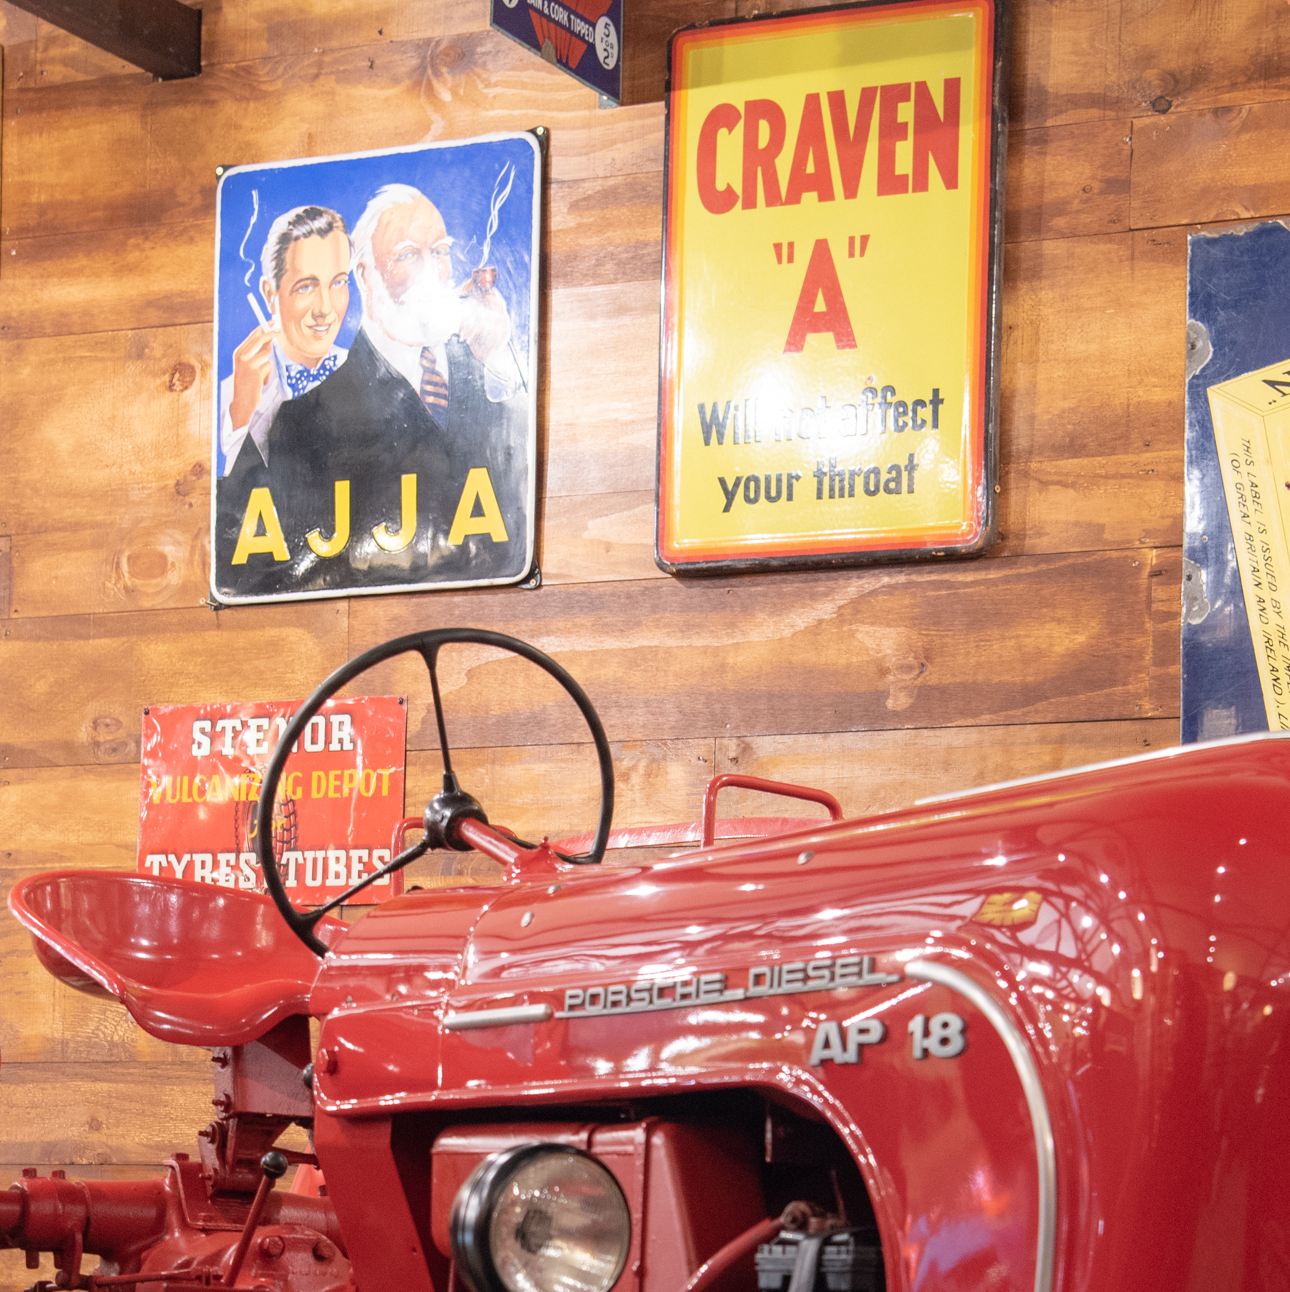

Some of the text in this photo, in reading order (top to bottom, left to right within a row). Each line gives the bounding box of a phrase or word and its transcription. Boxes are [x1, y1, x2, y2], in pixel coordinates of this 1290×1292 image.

[550, 2, 569, 28] CORK
[603, 22, 611, 38] 5
[696, 77, 961, 216] CRAVEN
[772, 234, 871, 355] "A"
[698, 397, 761, 446] Will
[841, 385, 945, 437] affect
[1230, 453, 1243, 478] (OF
[1241, 438, 1255, 467] THIS
[717, 453, 919, 513] your throat
[1235, 480, 1252, 528] GREAT
[1247, 471, 1264, 515] LABEL
[231, 467, 509, 565] AJJA
[1257, 521, 1267, 535] IS
[1245, 531, 1264, 592] BRITAIN
[1260, 538, 1278, 593] ISSUED
[1255, 596, 1270, 626] AND
[1271, 598, 1284, 618] BY
[1276, 621, 1289, 648] THE
[149, 768, 395, 805] VULCANIZNG DEPOT
[144, 848, 391, 891] TYRES TUBES
[564, 956, 878, 1014] PORSCHE DIESEL
[810, 1012, 966, 1067] AP 18
